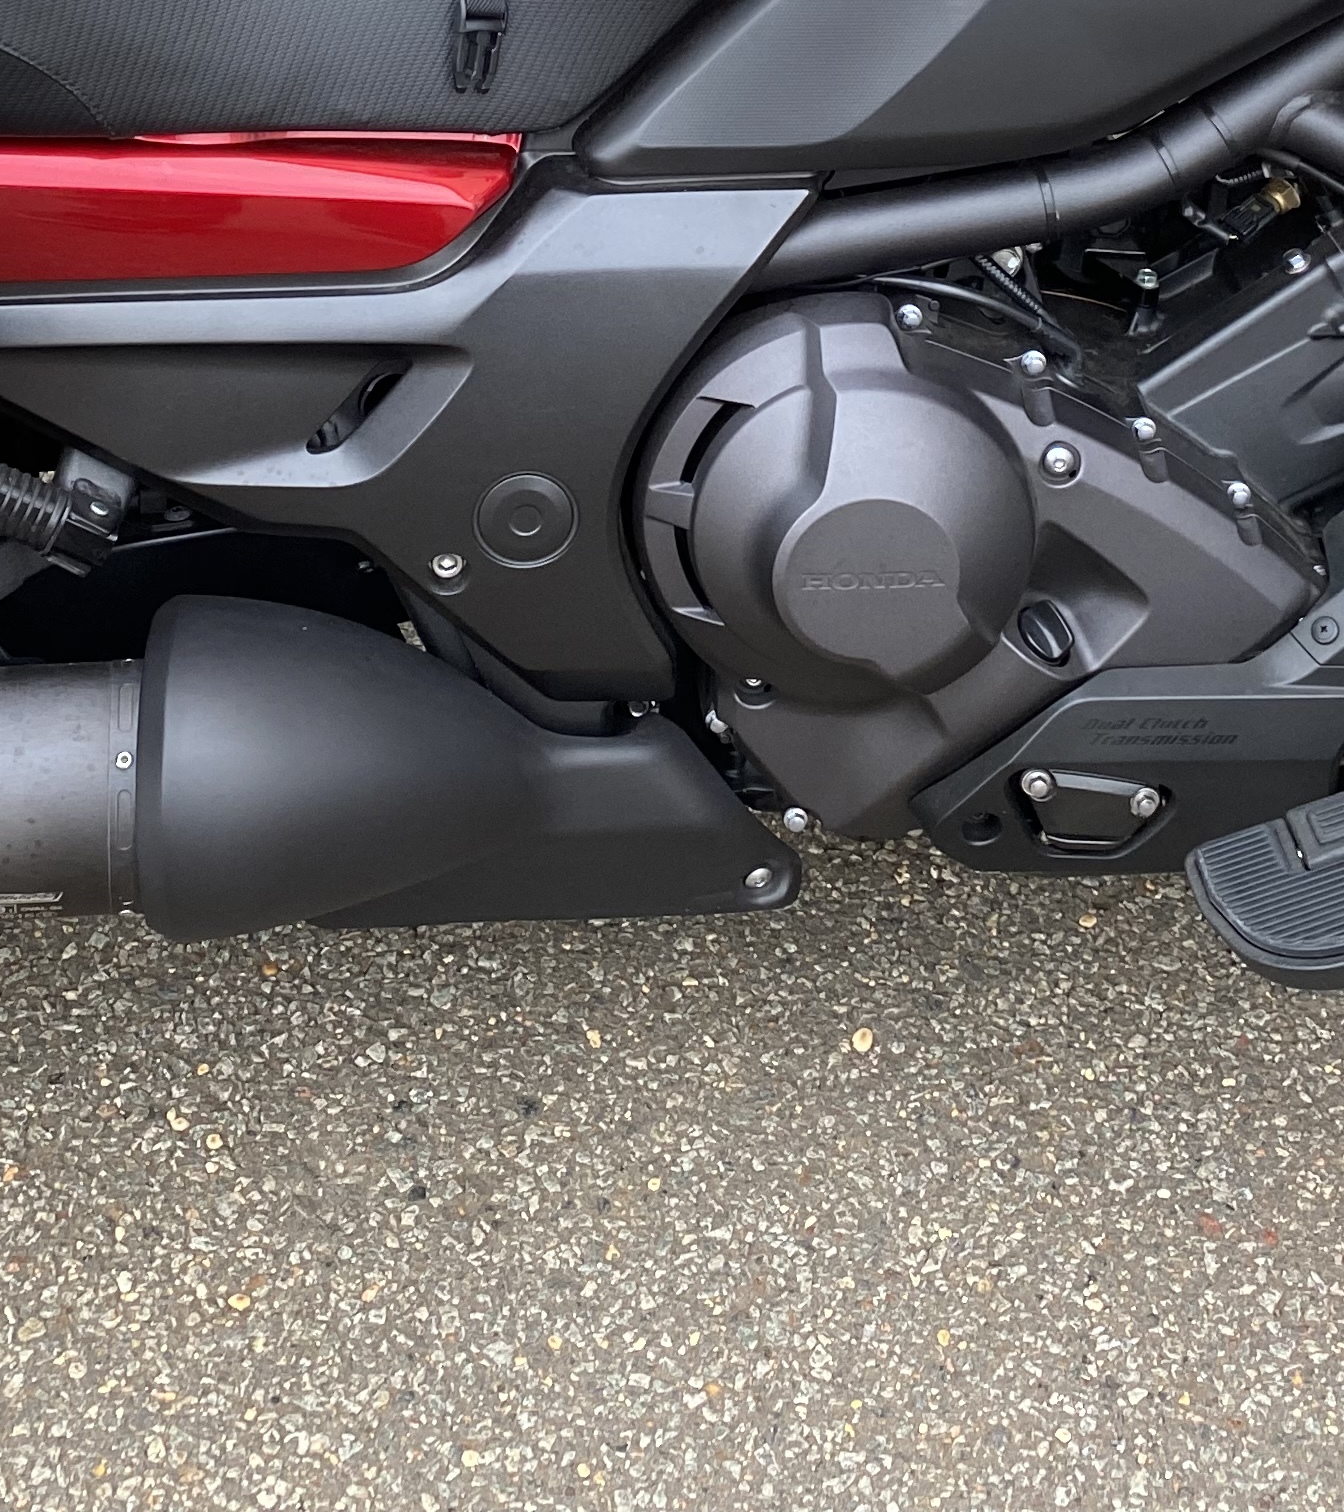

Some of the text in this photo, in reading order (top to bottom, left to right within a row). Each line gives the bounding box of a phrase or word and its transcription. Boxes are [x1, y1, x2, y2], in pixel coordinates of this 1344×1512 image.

[801, 569, 947, 591] HONDA
[1139, 717, 1209, 730] Clutch
[1089, 731, 1240, 746] Transmission
